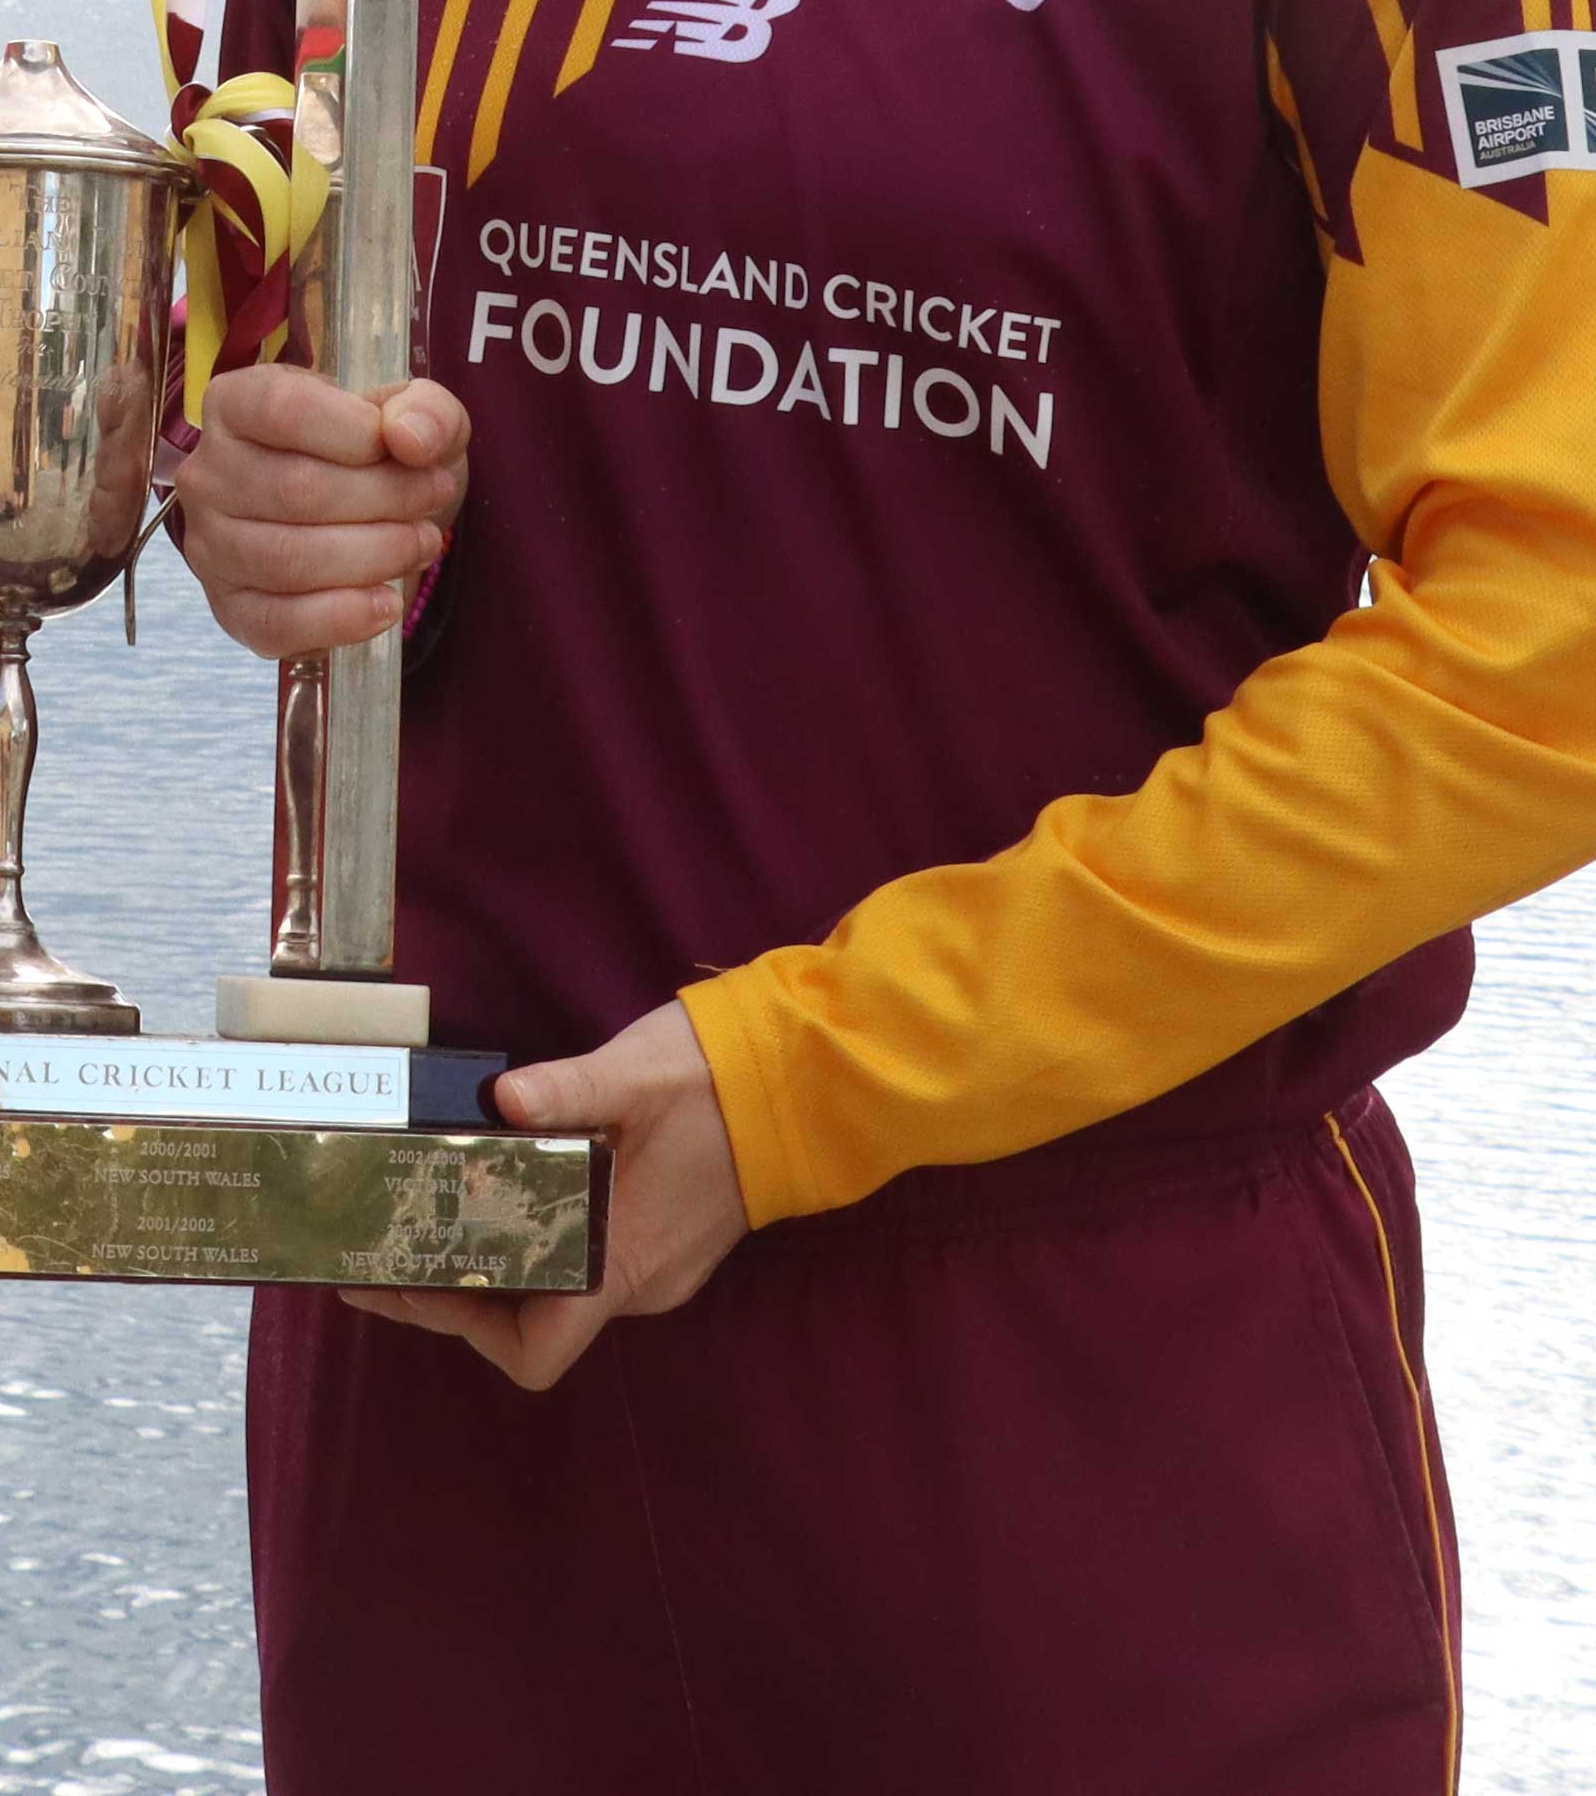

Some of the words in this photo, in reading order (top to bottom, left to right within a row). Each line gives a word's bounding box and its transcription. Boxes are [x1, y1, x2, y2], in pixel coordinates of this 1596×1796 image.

[1474, 105, 1555, 135] BRISBANE
[1478, 122, 1546, 150] AIRPORT
[1480, 140, 1536, 160] AUSTRALIA
[478, 218, 808, 311] QUEENSLAND
[822, 274, 1062, 365] CRICKET
[467, 291, 1055, 471] FOUNDATION
[79, 1062, 238, 1090] CRICKET
[257, 1068, 392, 1095] LEAGUE
[140, 1142, 217, 1159] 2000/2001
[389, 1150, 466, 1165] 2002/2003
[94, 1167, 135, 1183] NEW
[139, 1170, 200, 1186] SOUTH
[206, 1172, 261, 1187] WALES
[385, 1177, 468, 1194] VICTORIA
[137, 1217, 215, 1234] 2001/2002
[92, 1244, 133, 1258] NEW
[137, 1246, 198, 1261] SOUTH
[203, 1248, 259, 1263] WALES
[342, 1252, 381, 1266] NEW
[388, 1253, 446, 1269] SOUTH
[451, 1255, 506, 1270] WALES
